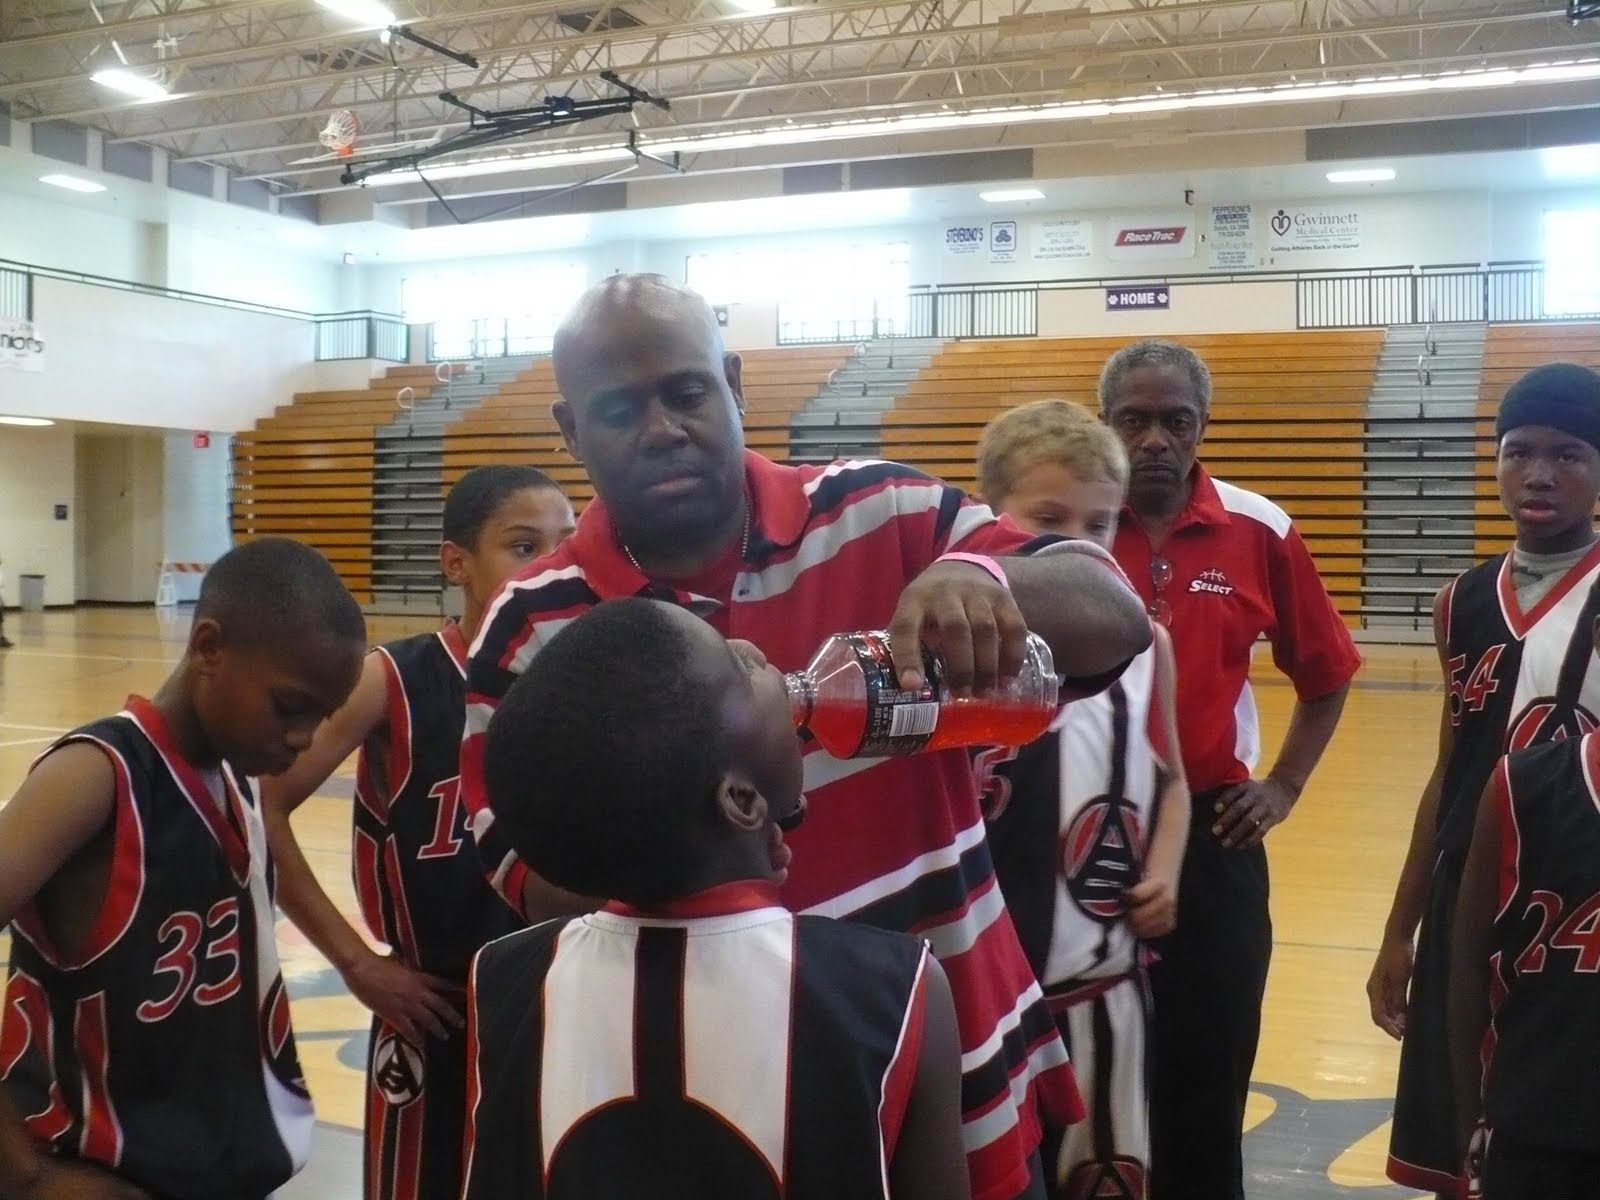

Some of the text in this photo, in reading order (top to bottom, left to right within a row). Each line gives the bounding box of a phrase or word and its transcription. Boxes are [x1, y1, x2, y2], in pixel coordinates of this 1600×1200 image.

[1294, 213, 1359, 226] Gwinnett
[1296, 226, 1358, 235] Medical Center
[1120, 292, 1155, 305] HOME
[1447, 643, 1507, 727] 54
[1513, 889, 1600, 978] 24
[136, 896, 242, 1023] 33
